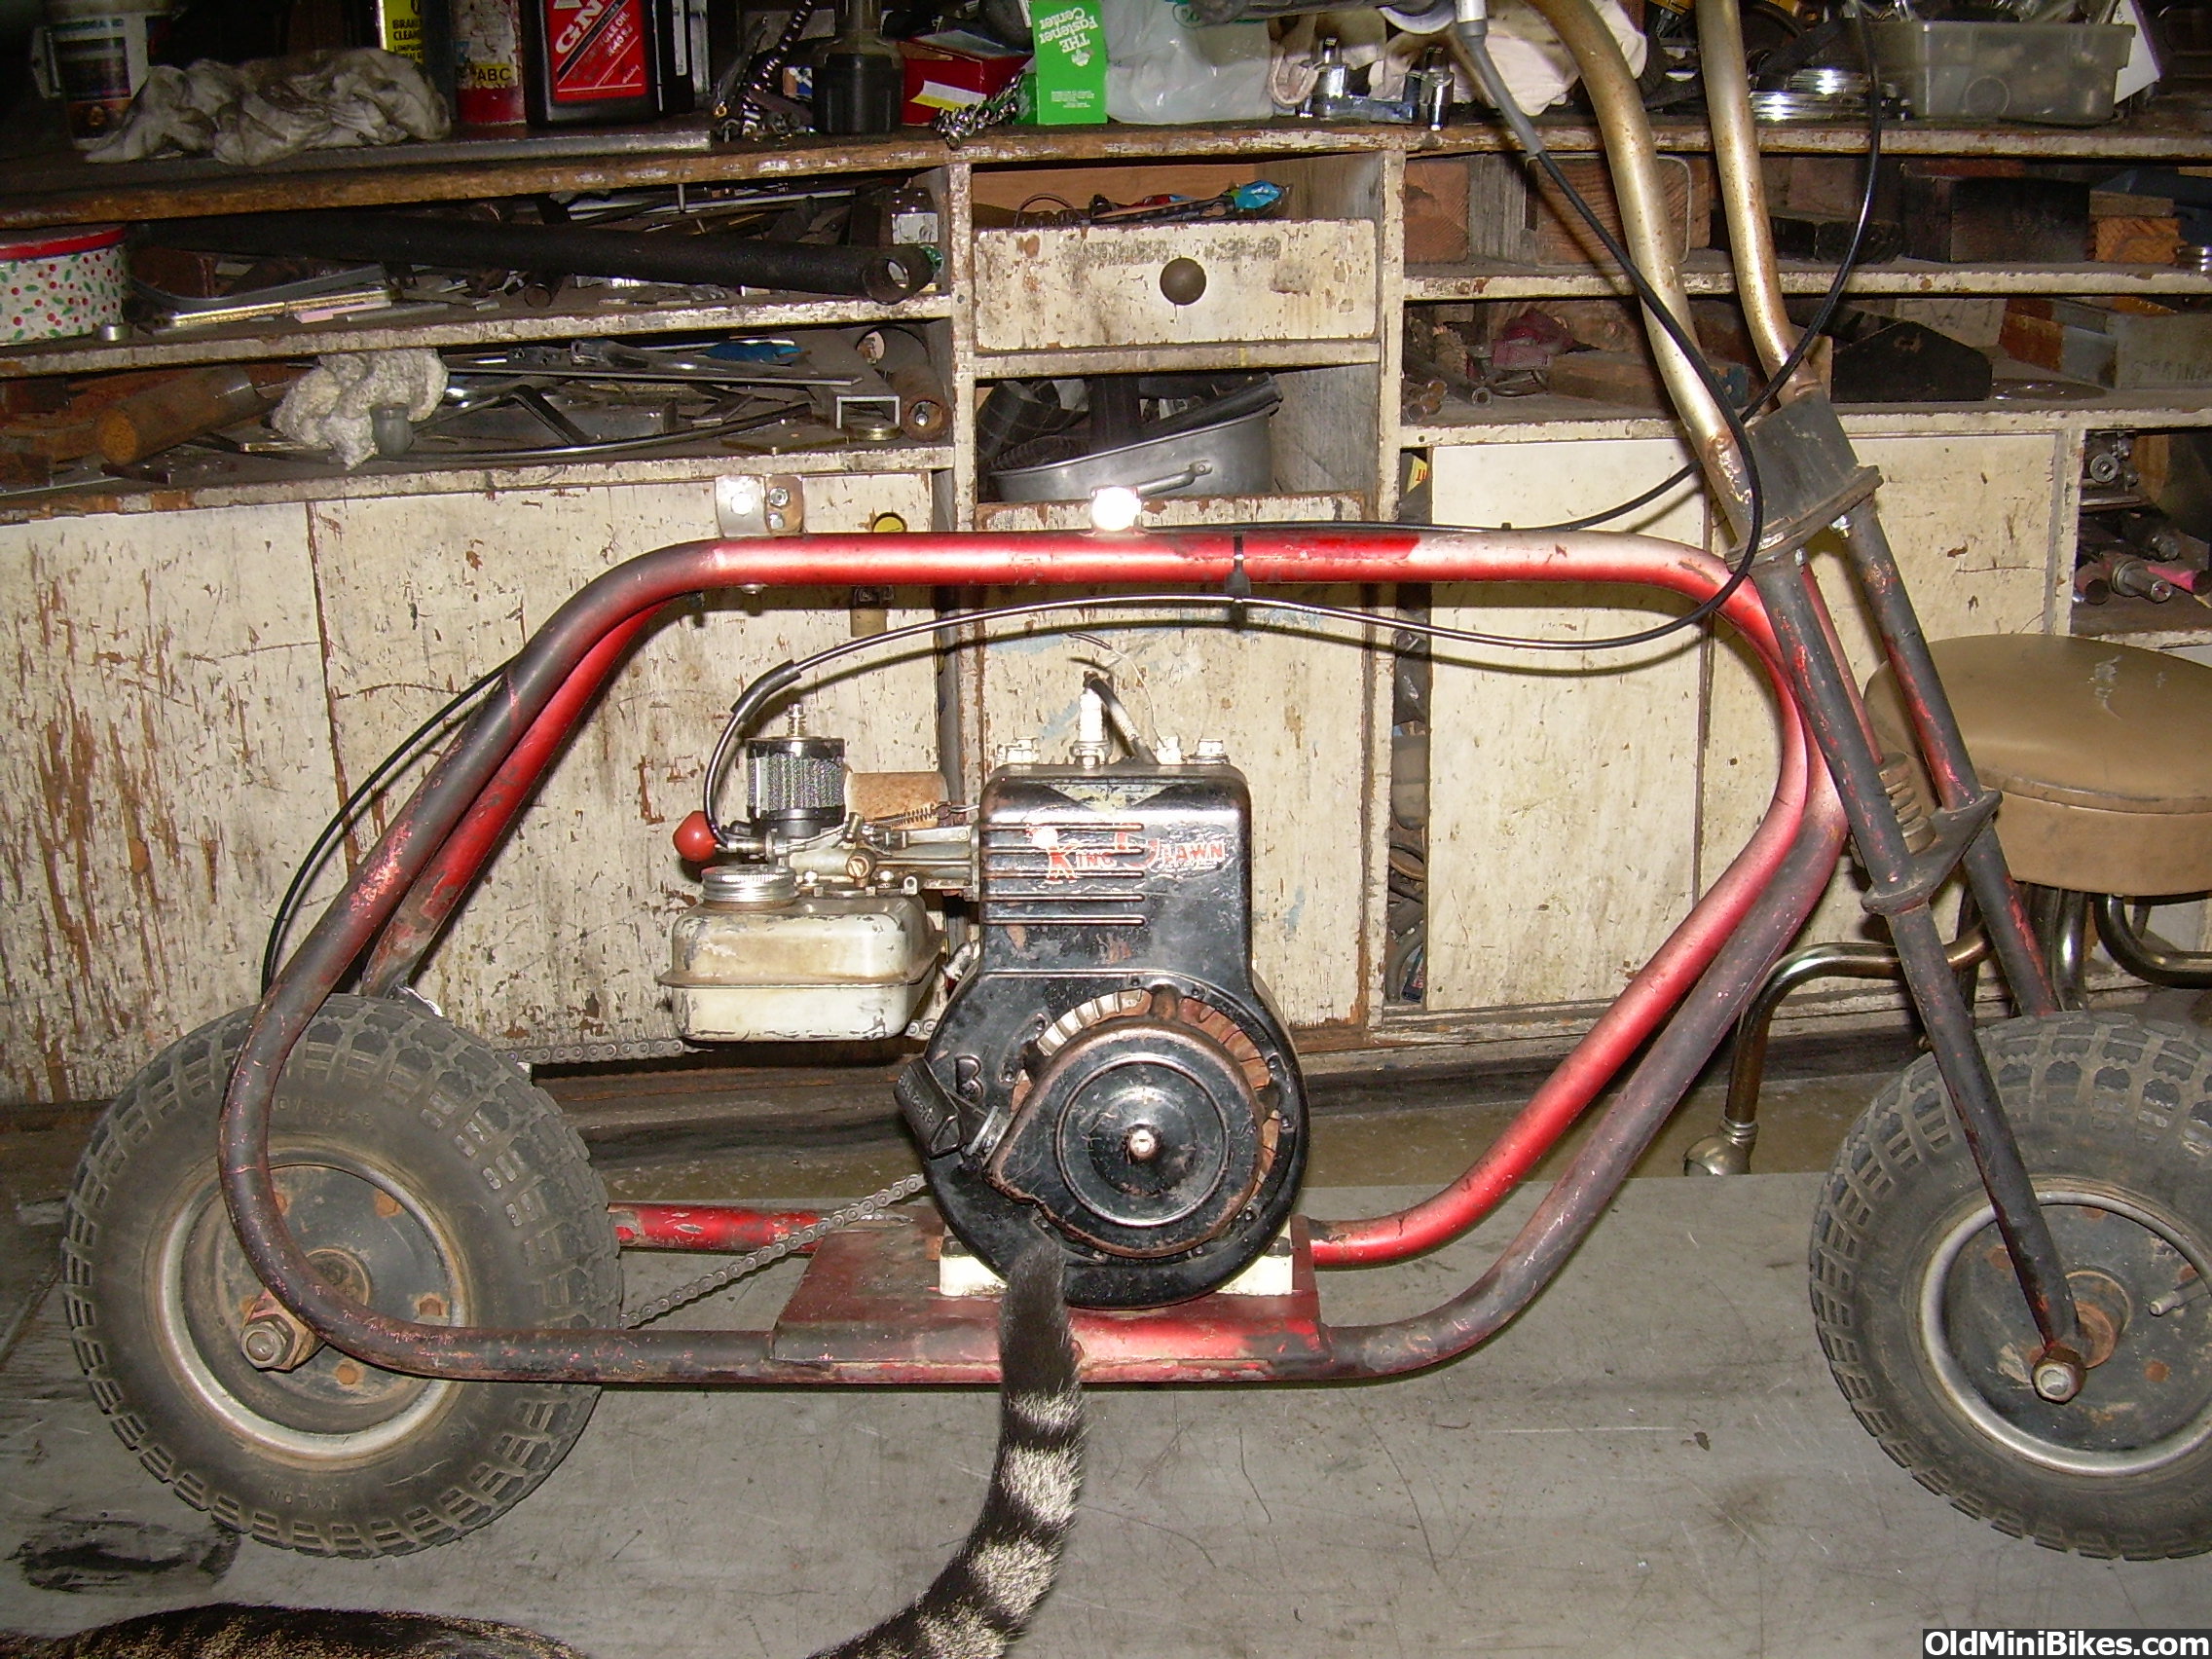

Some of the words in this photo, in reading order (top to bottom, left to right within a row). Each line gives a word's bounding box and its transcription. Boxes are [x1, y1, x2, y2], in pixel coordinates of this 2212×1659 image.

[1039, 7, 1086, 30] Center
[1039, 16, 1098, 45] Fastener
[1058, 32, 1090, 54] THE
[477, 67, 512, 82] ABC
